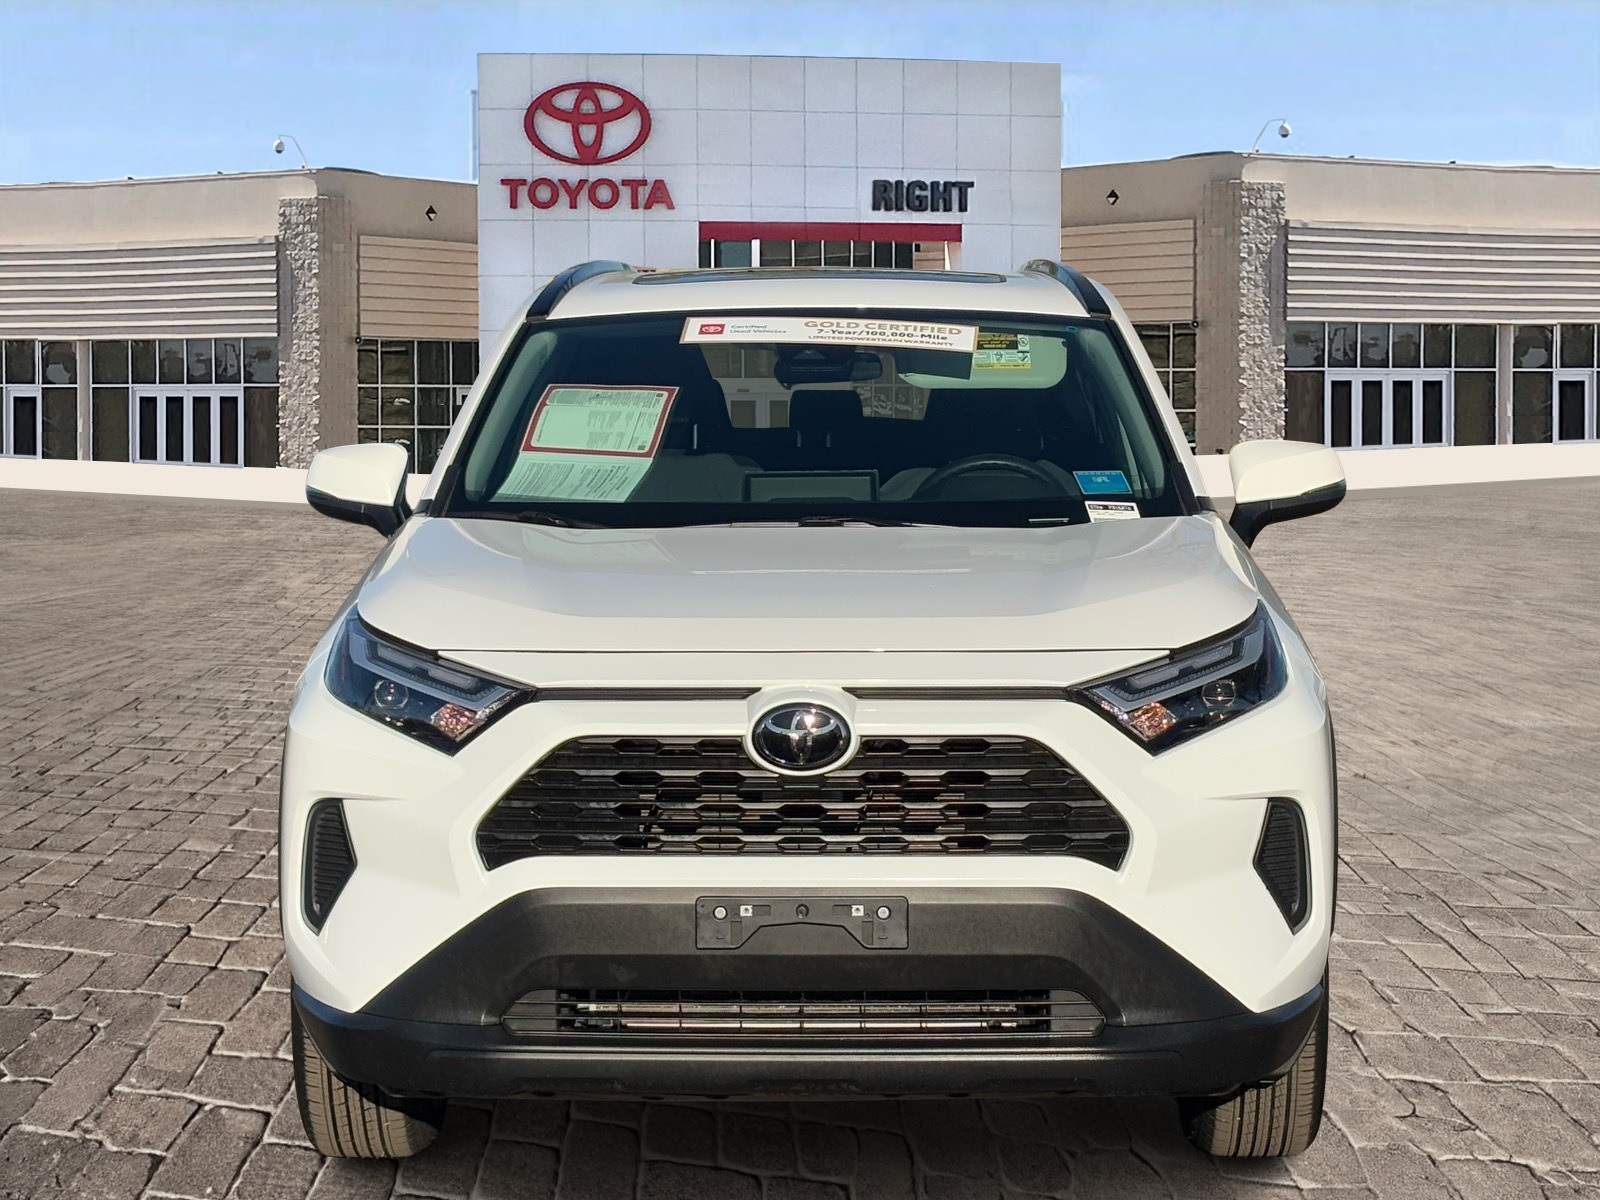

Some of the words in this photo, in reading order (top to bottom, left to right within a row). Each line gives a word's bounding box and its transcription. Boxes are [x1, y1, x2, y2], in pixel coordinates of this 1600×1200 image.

[501, 178, 674, 210] TOYOTA
[871, 179, 975, 213] RIGHT
[803, 320, 860, 330] GOLD
[864, 322, 962, 335] CERTIFIED
[816, 328, 948, 341] 7-Year/100,000-Mile
[904, 339, 954, 347] WARRANTY
